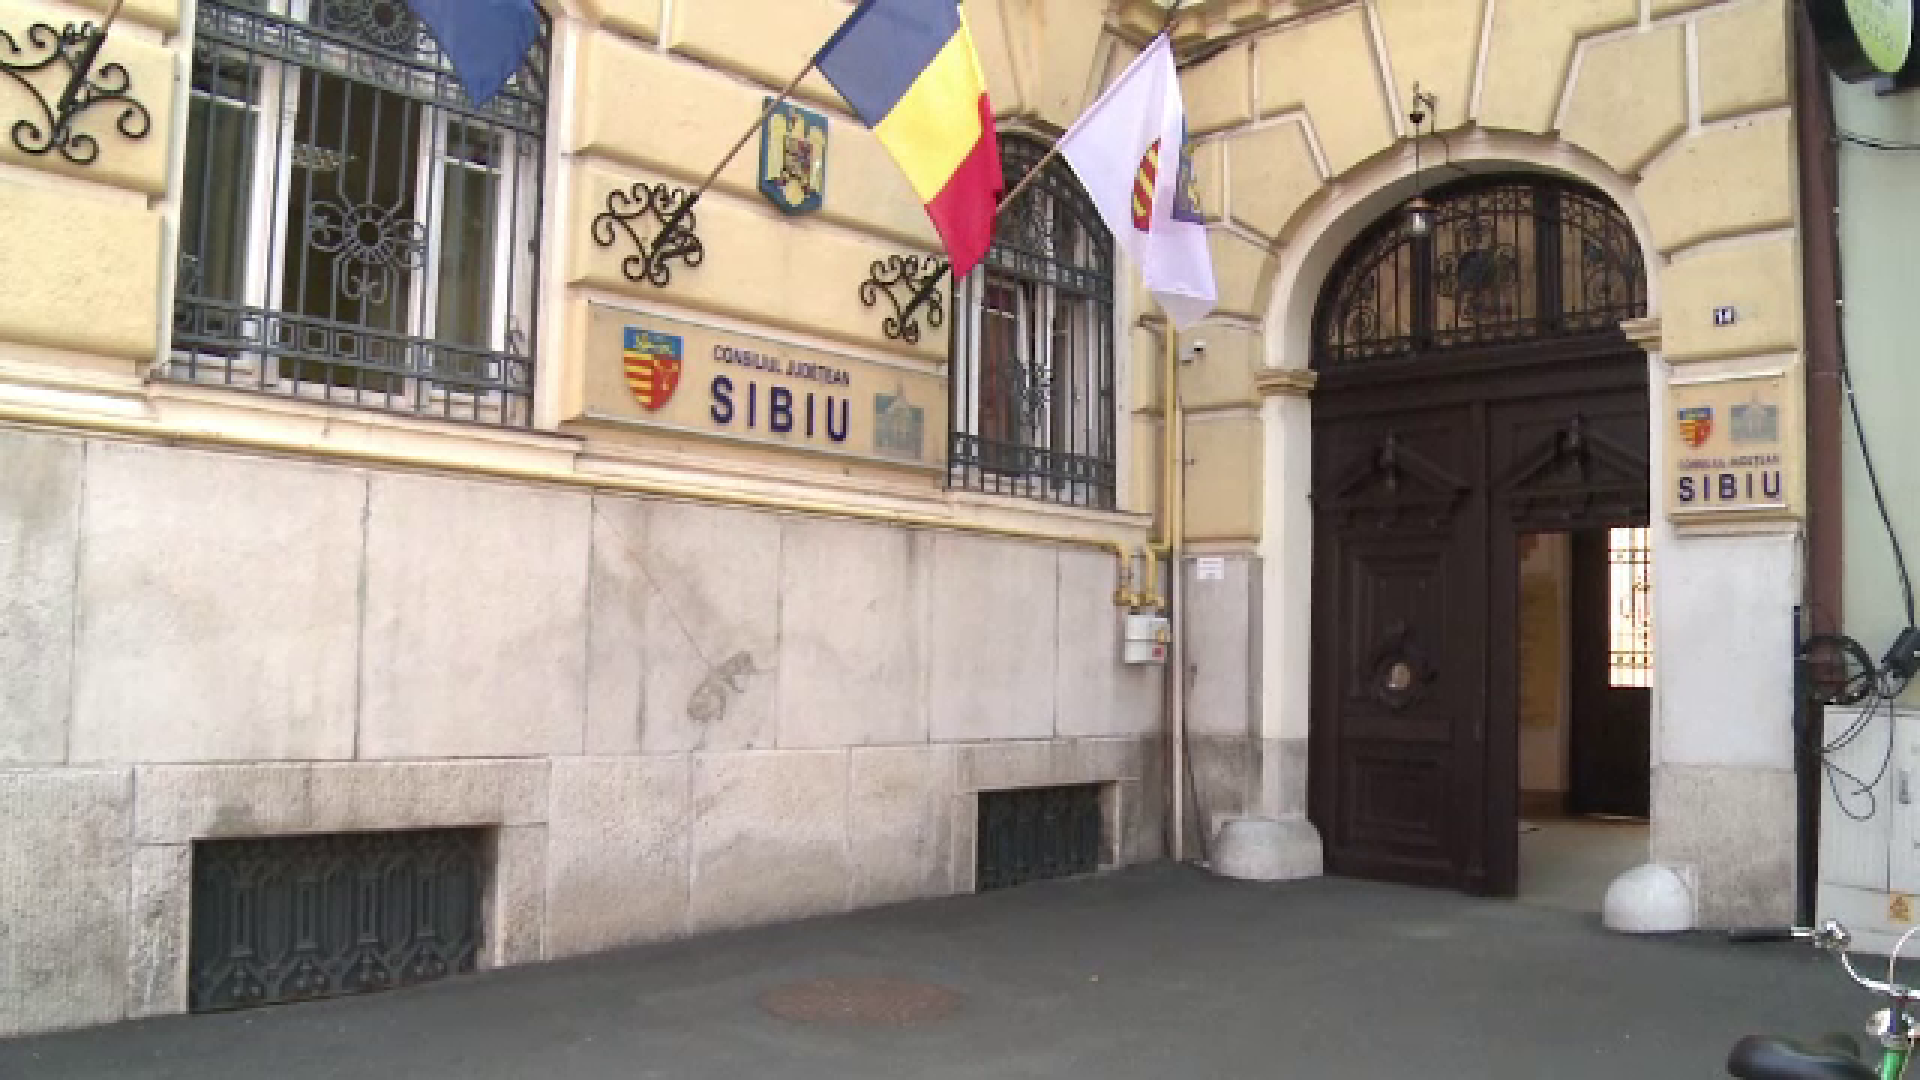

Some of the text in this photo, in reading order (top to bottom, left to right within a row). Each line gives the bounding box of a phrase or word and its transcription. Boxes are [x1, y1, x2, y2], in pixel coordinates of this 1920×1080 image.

[714, 345, 782, 373] CONSILIUL
[710, 375, 849, 442] SIBIU
[1679, 471, 1780, 501] SIBIU
